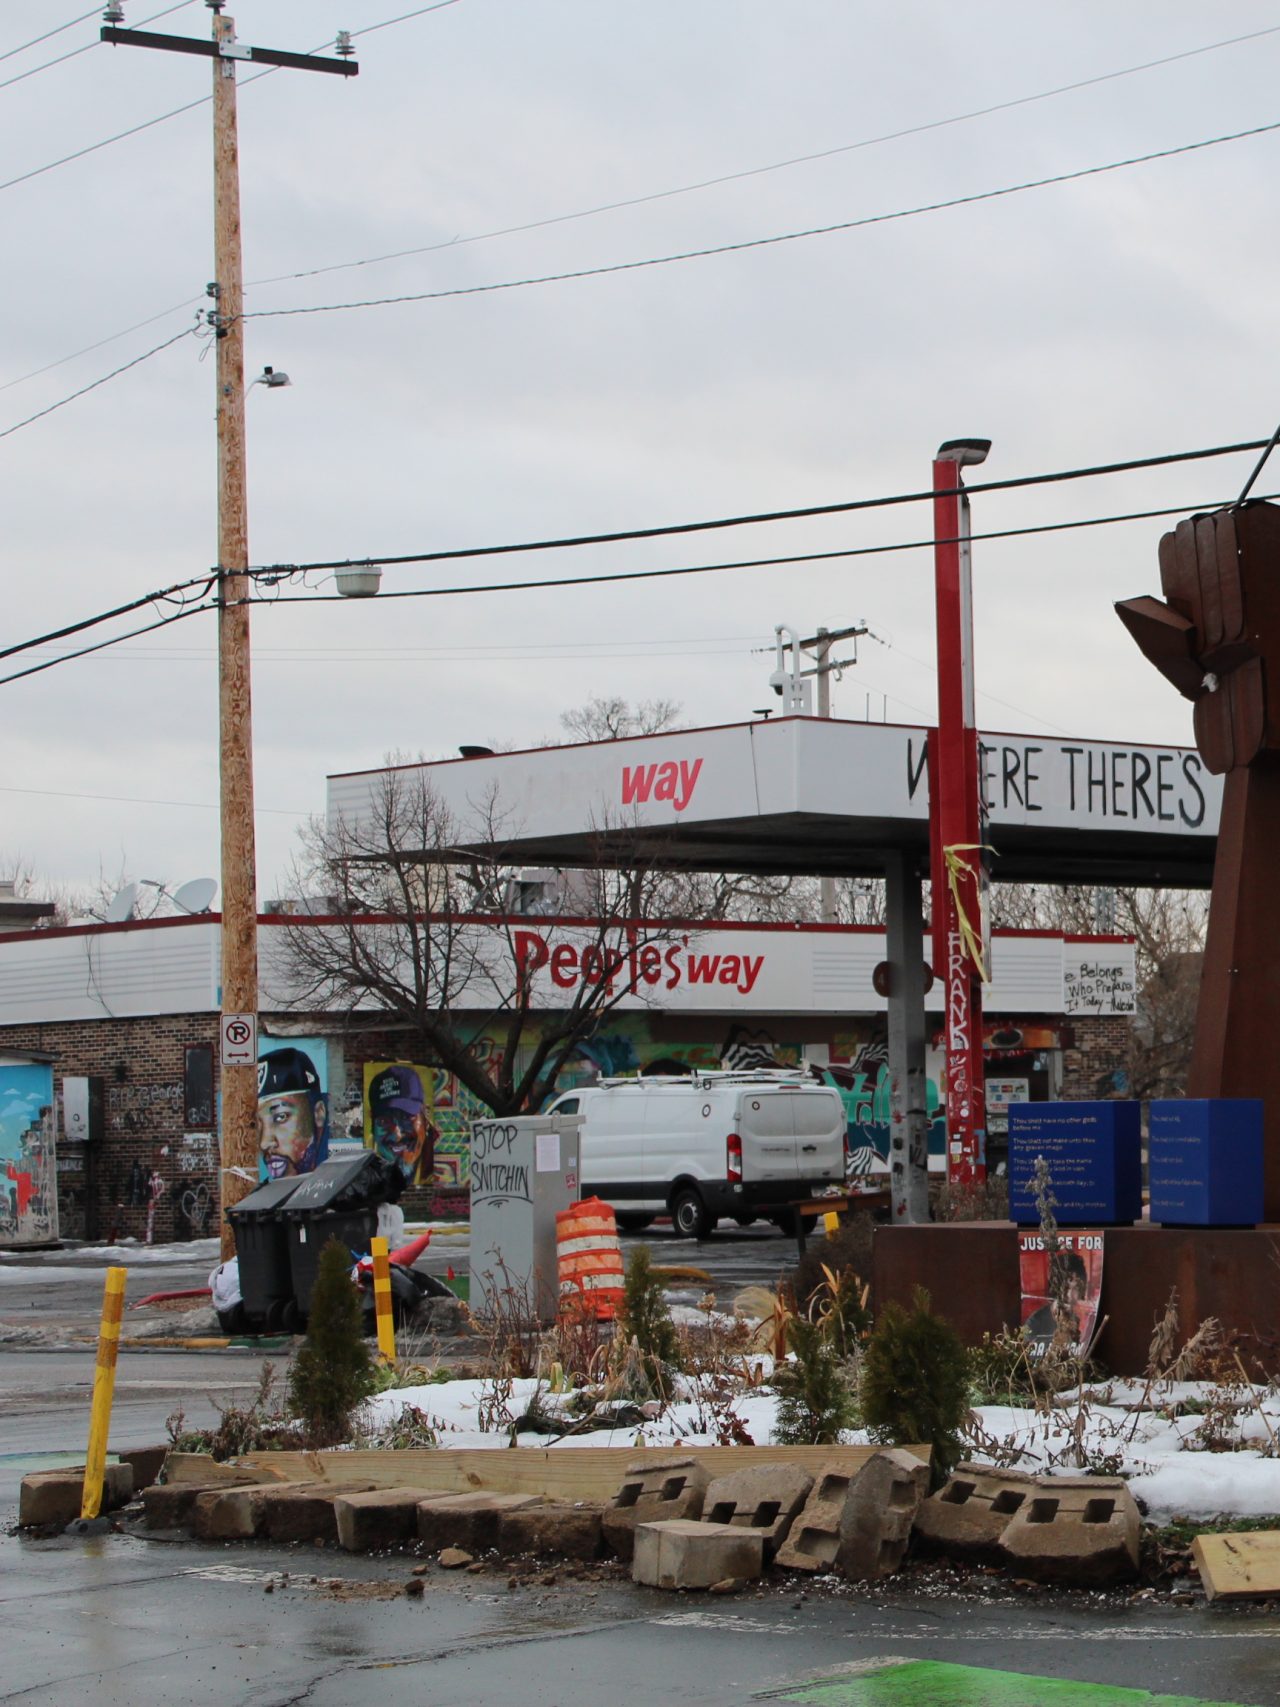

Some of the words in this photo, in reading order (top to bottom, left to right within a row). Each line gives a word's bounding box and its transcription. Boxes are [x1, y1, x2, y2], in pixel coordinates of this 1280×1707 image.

[621, 758, 704, 811] way
[1060, 747, 1206, 829] THERE'S
[1080, 962, 1123, 981] Belongs
[1068, 982, 1093, 997] Who
[1081, 996, 1104, 1015] Today
[473, 1123, 518, 1159] STOP
[471, 1161, 530, 1198] SNITCHIN
[1020, 1237, 1073, 1250] JUSCE
[1078, 1237, 1102, 1250] FOR
